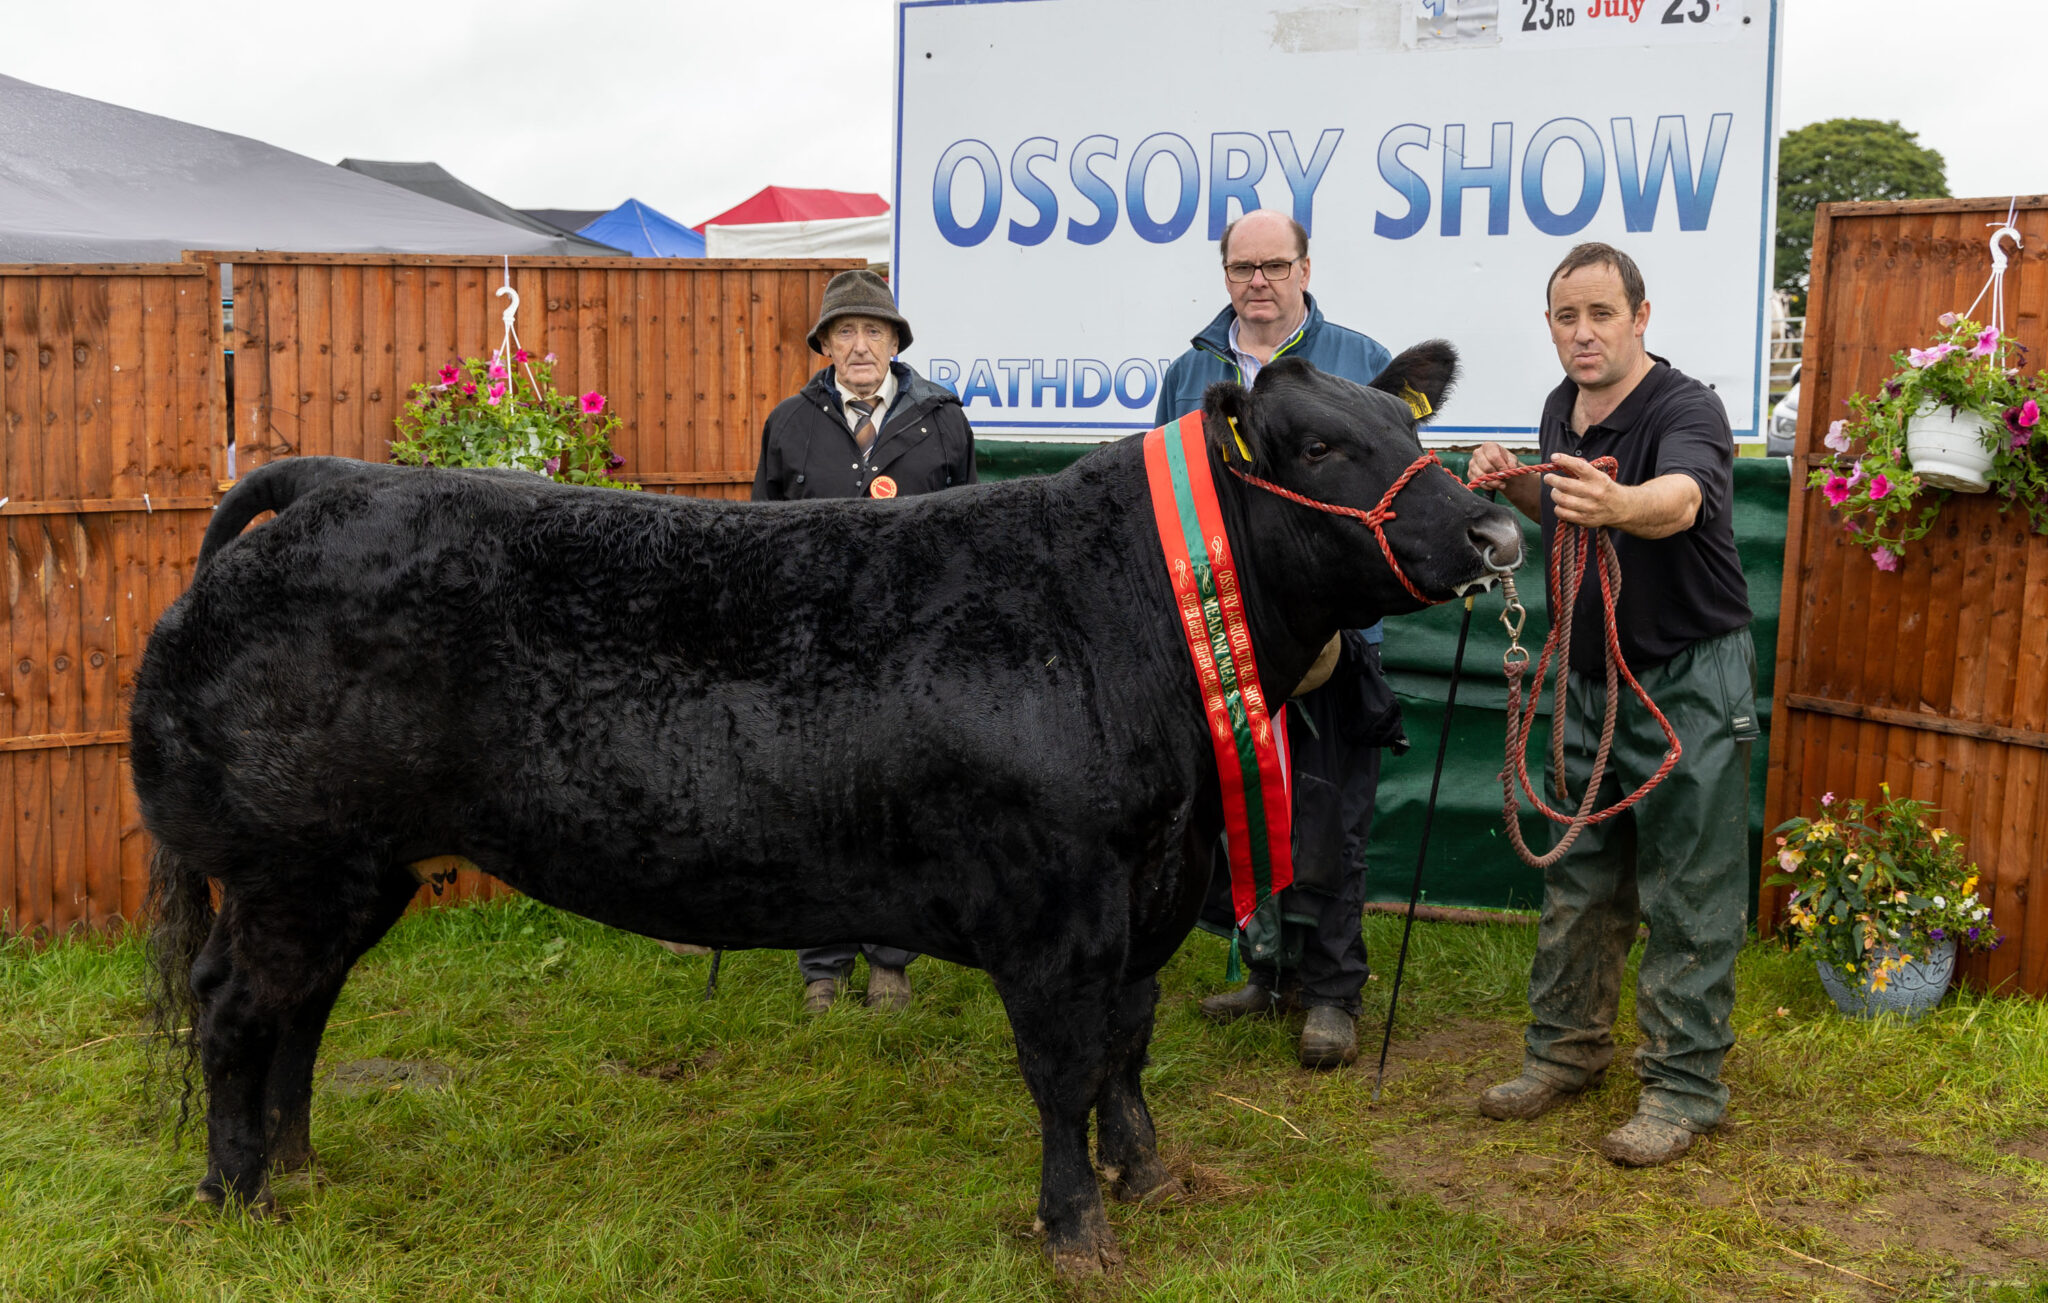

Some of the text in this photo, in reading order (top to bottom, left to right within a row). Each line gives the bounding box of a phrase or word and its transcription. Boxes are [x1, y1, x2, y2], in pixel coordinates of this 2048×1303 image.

[1587, 0, 1647, 24] July
[933, 112, 1734, 247] OSSORY SHOW
[930, 357, 1170, 410] RATHDO
[1180, 592, 1224, 713] SUPER BEEF HEIFER CHAMPION
[1203, 595, 1241, 700] MEADOW MEATS
[1218, 569, 1265, 715] OSSORY AGRICULTURAL SHOW
